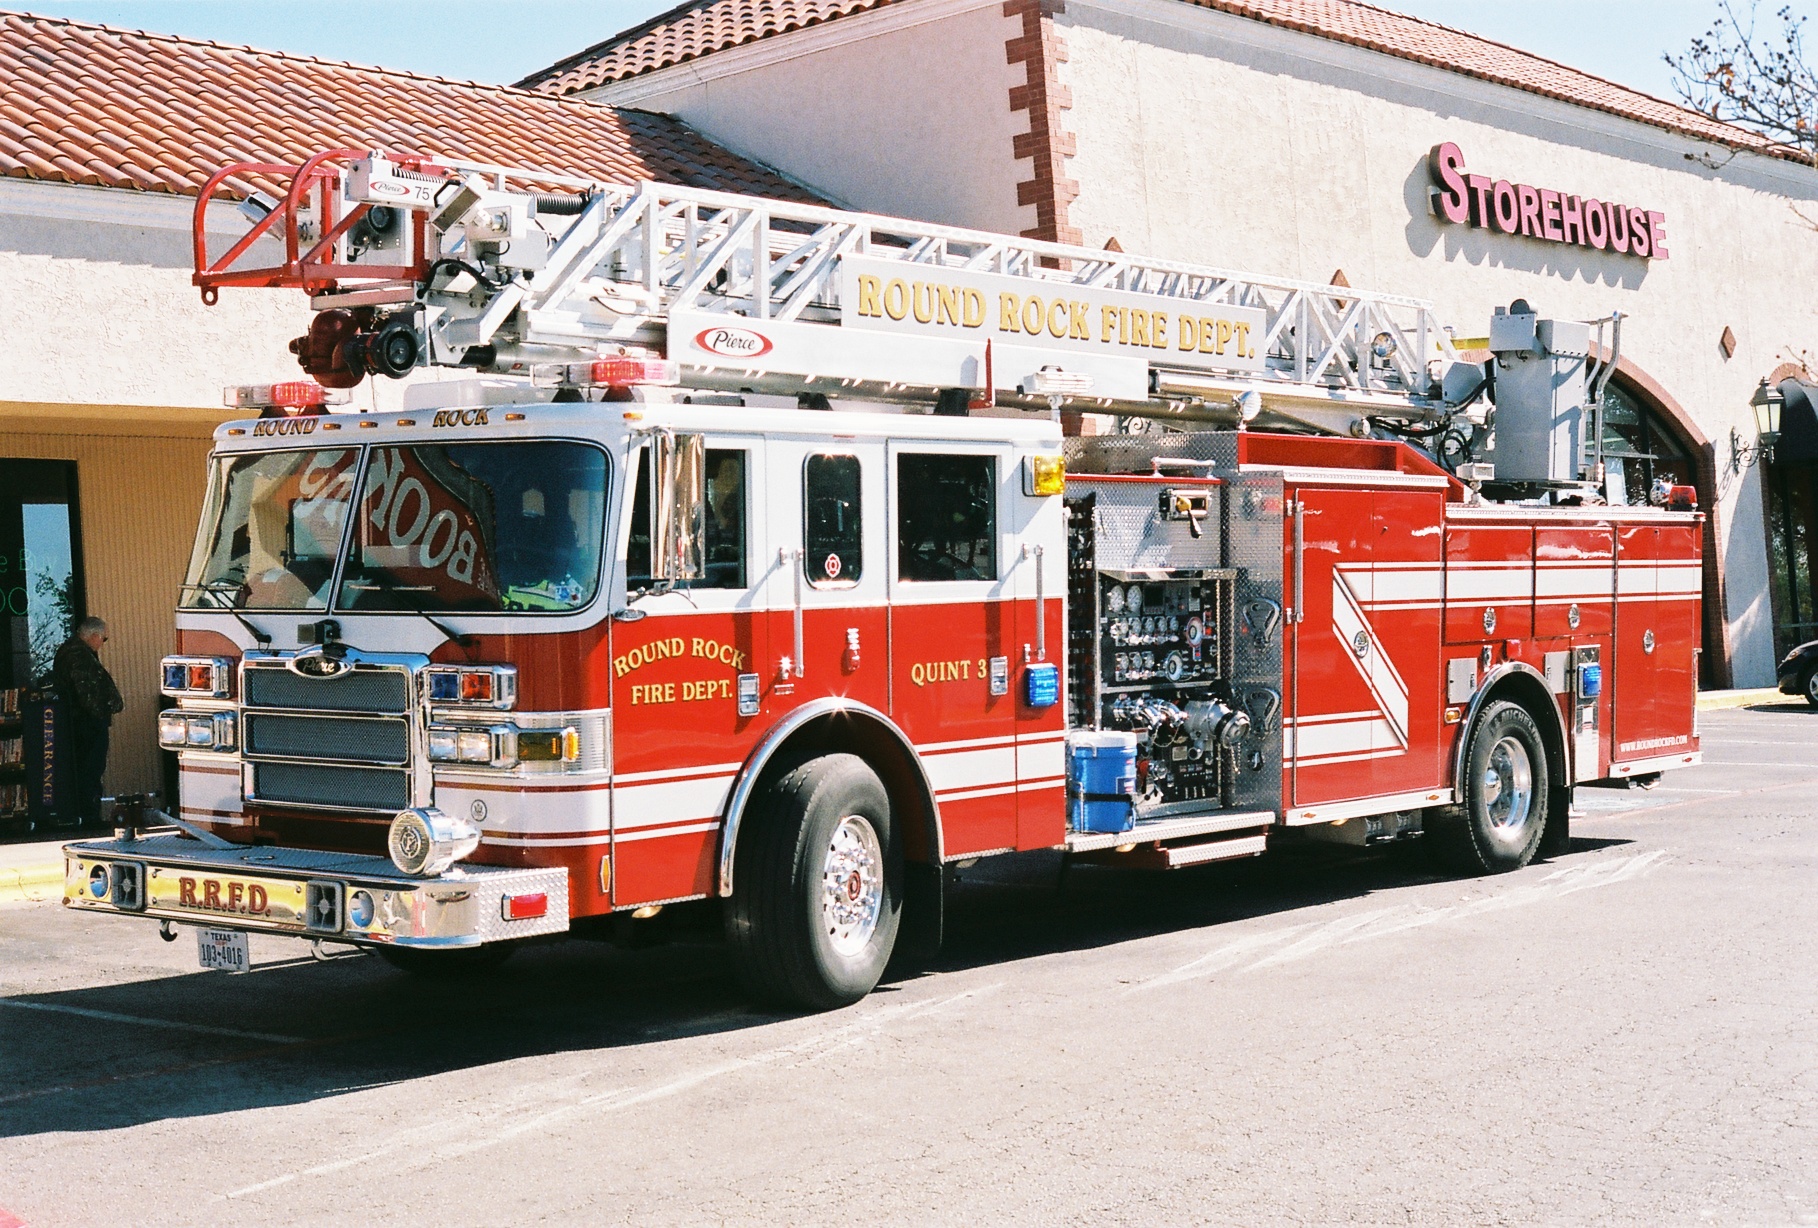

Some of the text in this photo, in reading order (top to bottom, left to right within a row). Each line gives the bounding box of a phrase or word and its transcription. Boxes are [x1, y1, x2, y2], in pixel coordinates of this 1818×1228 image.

[1430, 142, 1669, 260] STOREHOUSE
[857, 274, 1256, 359] ROUND ROCK FIRE DEPT.
[712, 330, 756, 350] Pierce
[253, 407, 493, 437] ROUND ROCK
[613, 637, 746, 678] ROUND ROCK
[911, 658, 988, 687] QUINT 3
[631, 679, 734, 705] FIRE DEPT.
[43, 707, 54, 805] CLEARANCE
[210, 932, 232, 942] TEXAS
